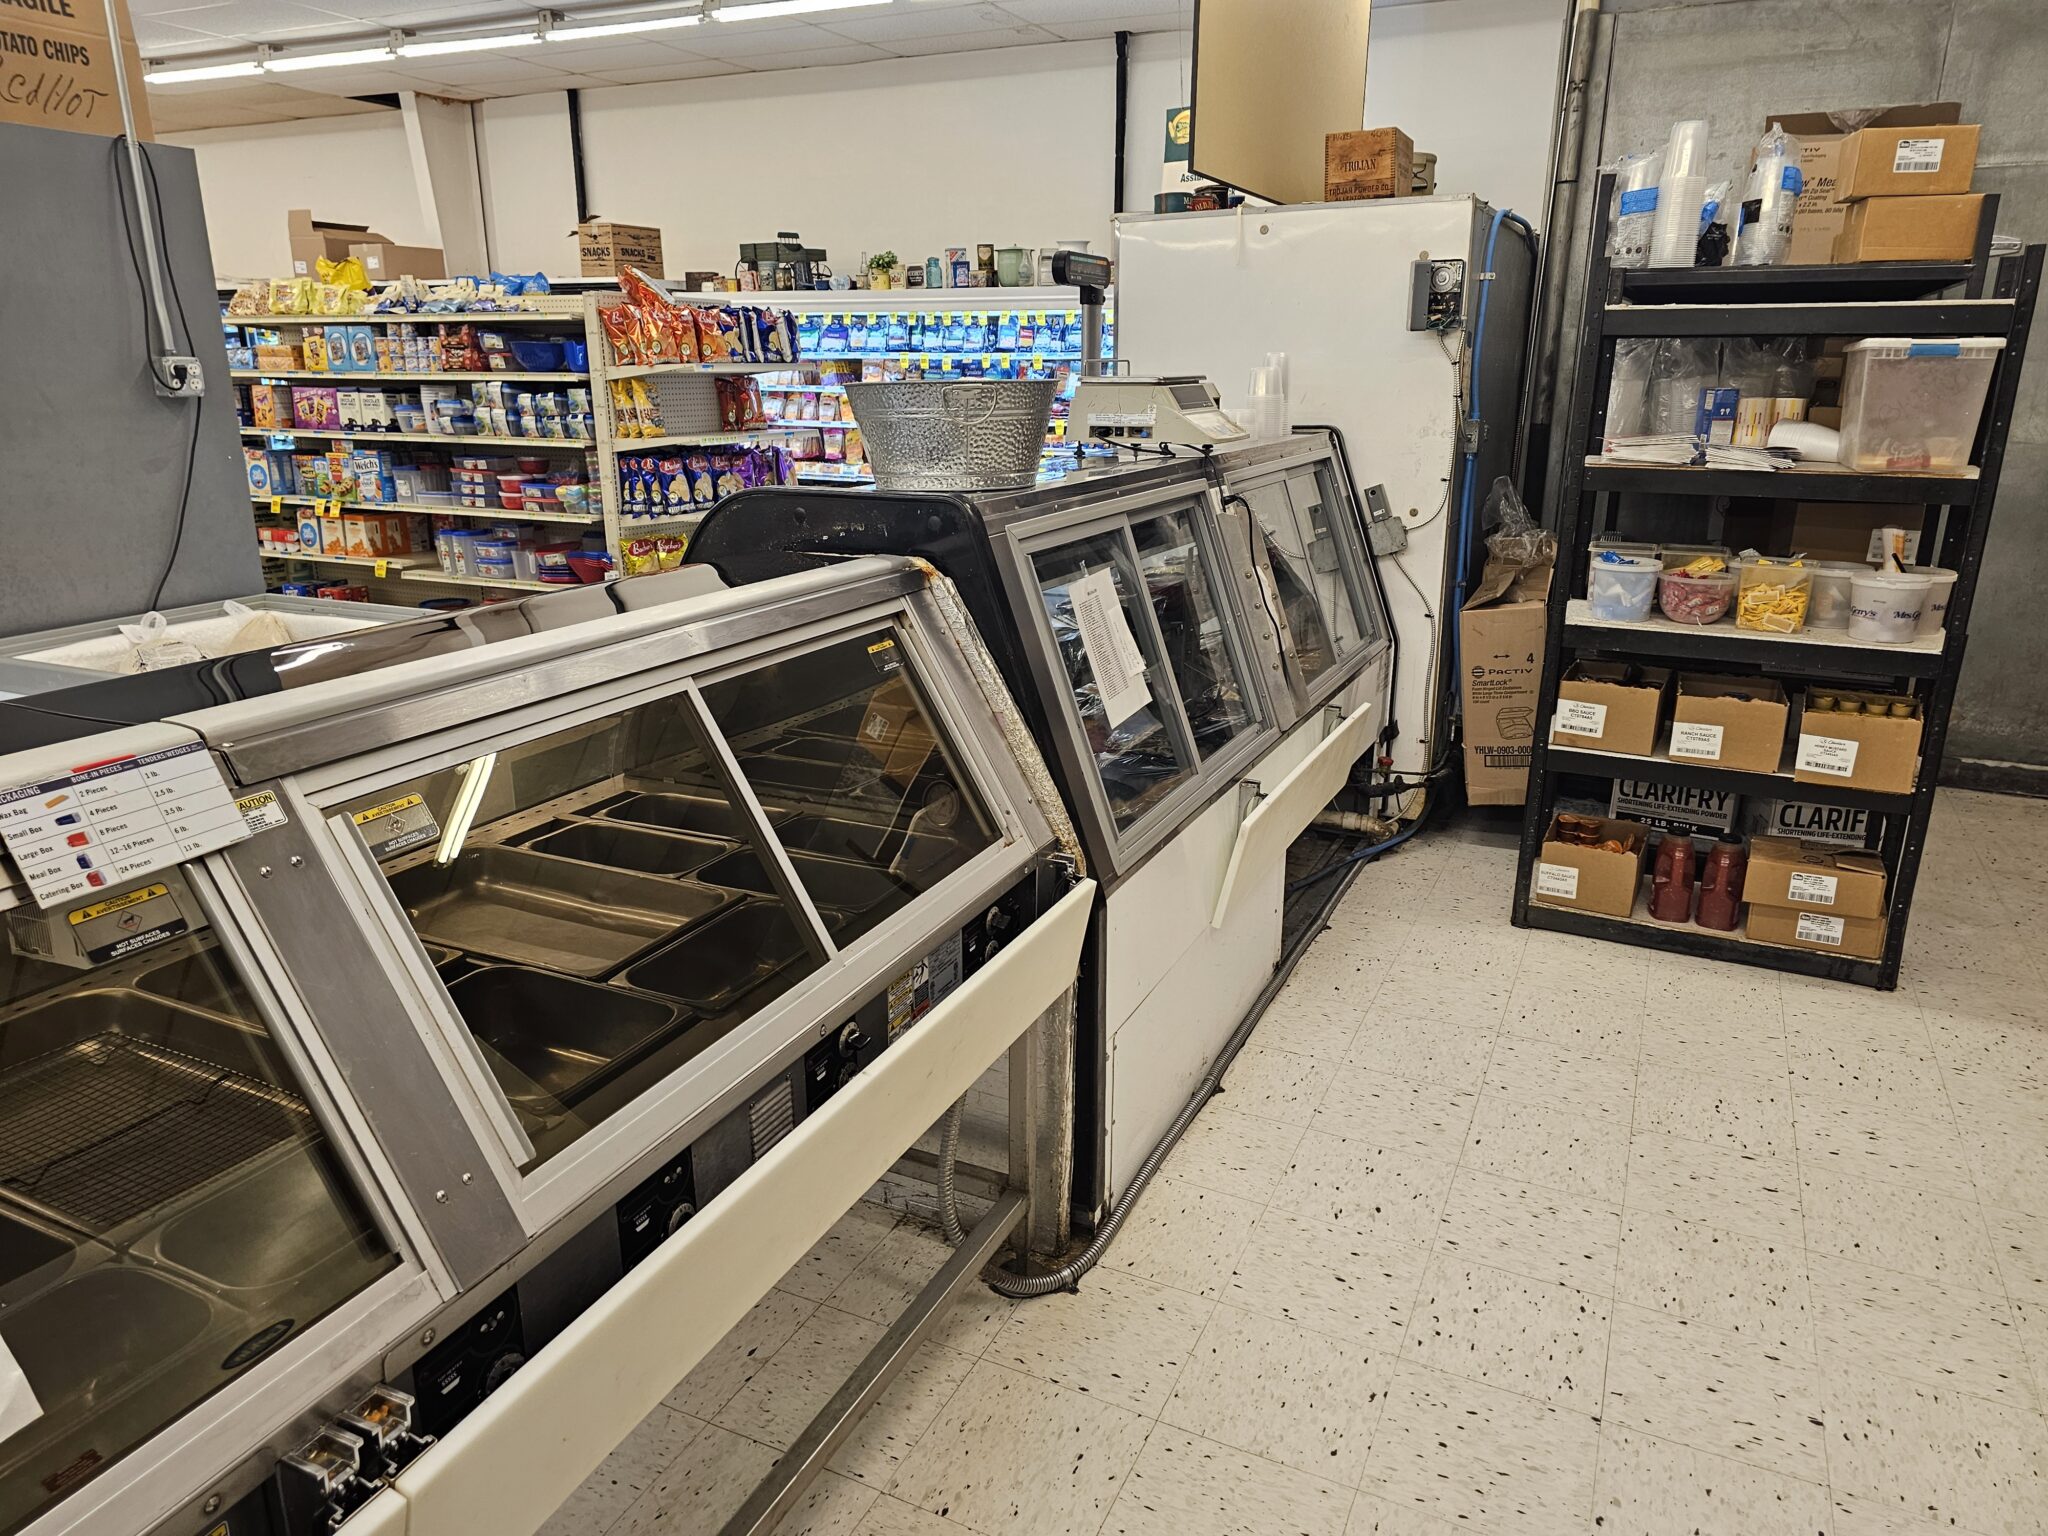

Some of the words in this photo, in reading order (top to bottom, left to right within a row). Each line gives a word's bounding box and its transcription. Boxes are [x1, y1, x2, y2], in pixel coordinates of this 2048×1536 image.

[0, 31, 38, 57] TATO
[43, 39, 90, 66] CHIPS
[1344, 158, 1376, 172] TROJAN
[1329, 186, 1352, 196] TROJAN
[1354, 184, 1380, 194] POWDER
[582, 247, 610, 257] SNACKS
[621, 248, 646, 257] SNACKS
[354, 458, 379, 470] Welch's
[1527, 652, 1534, 664] 4
[70, 774, 99, 783] BONE-IN
[100, 765, 122, 775] PIECES
[151, 770, 160, 778] lb.
[0, 786, 41, 804] CKAGING
[86, 786, 108, 795] Pieces
[166, 787, 176, 795] lb.
[1620, 780, 1729, 811] CLARIFRY
[12, 808, 28, 817] Bag
[95, 804, 118, 814] Pieces
[1617, 797, 1653, 809] SHORTENING
[1654, 803, 1700, 816] LIFE-EXTENDING
[1701, 809, 1728, 819] POWDER
[1780, 804, 1866, 832] CLARIF
[8, 830, 28, 840] Small
[29, 826, 43, 834] Box
[105, 823, 128, 834] Pieces
[1778, 828, 1816, 837] SHORTENING
[1817, 831, 1867, 840] LIFE-EXTENDING
[133, 837, 154, 847] Pieces
[18, 851, 39, 861] Large
[40, 846, 54, 854] Box
[29, 870, 47, 880] Meal
[48, 866, 62, 875] Box
[120, 866, 128, 874] 24
[129, 859, 152, 870] Pieces
[40, 887, 70, 900] Catering
[70, 882, 84, 890] Box
[105, 895, 131, 906] CAUTION
[110, 942, 142, 957] SURFACES
[143, 931, 170, 945] CHAUDES
[116, 941, 129, 949] HOT
[130, 929, 160, 944] SURFACES
